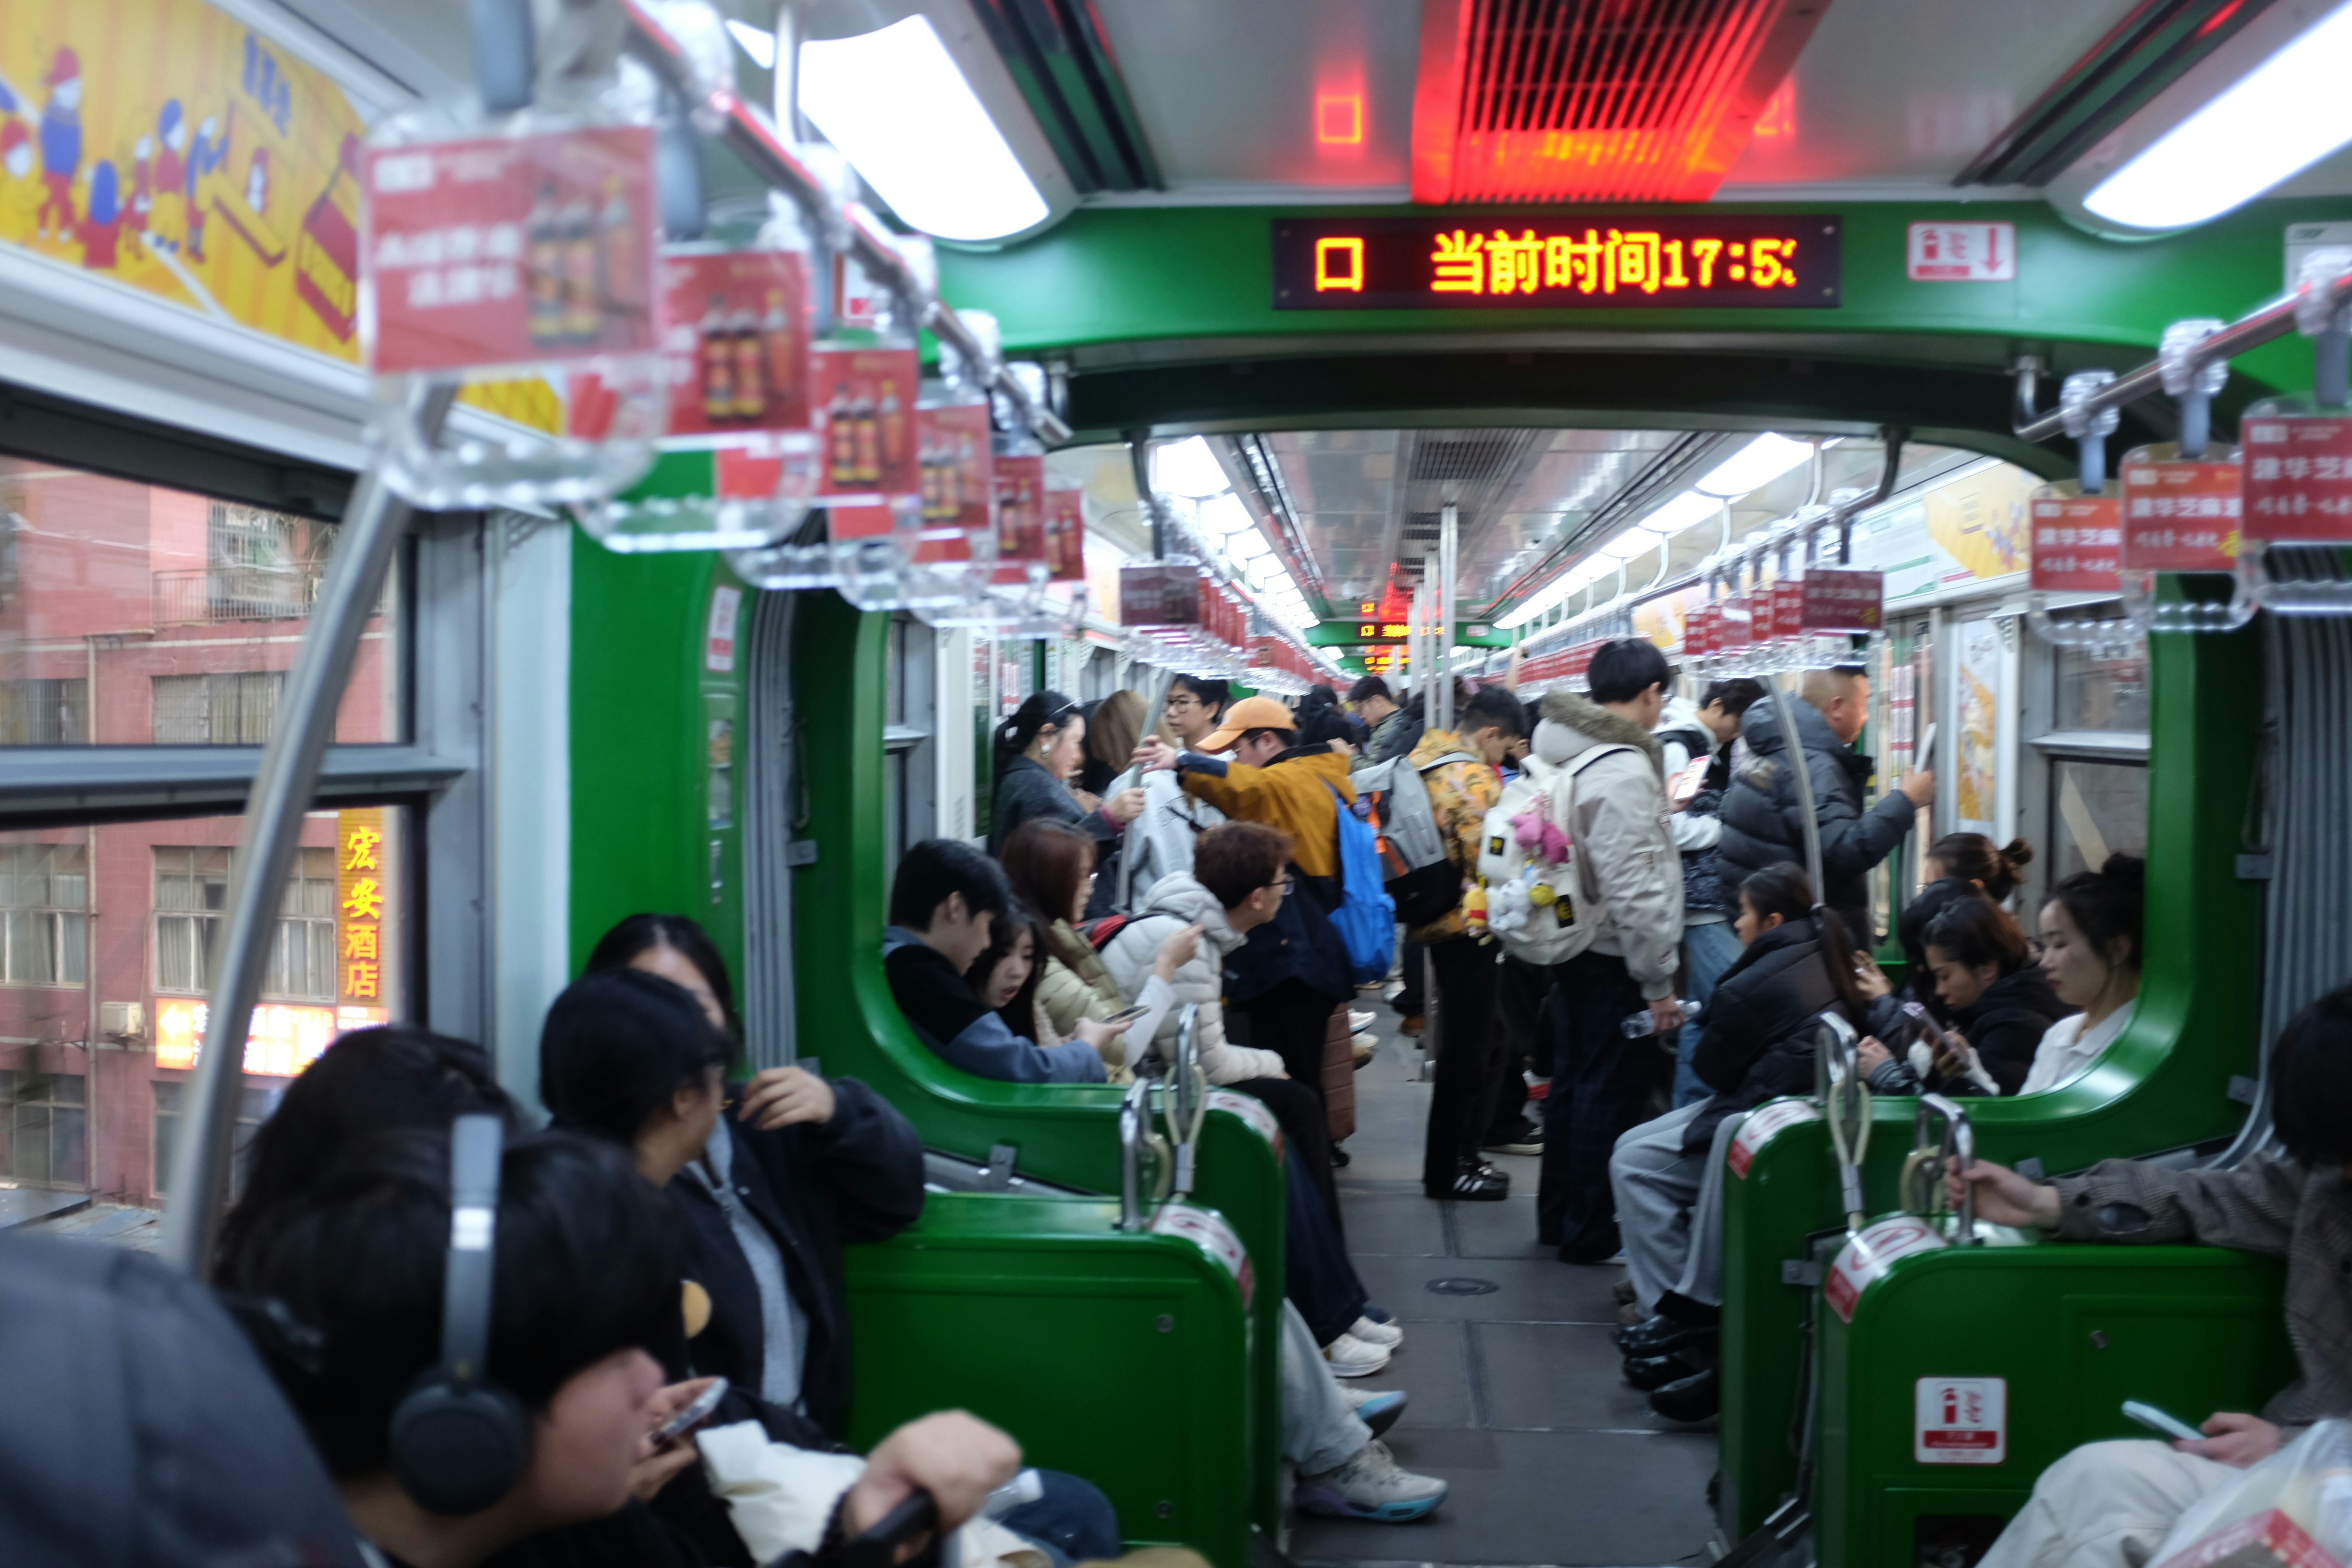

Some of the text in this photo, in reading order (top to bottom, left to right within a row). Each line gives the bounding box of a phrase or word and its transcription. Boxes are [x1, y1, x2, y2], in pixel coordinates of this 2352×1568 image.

[1316, 237, 1363, 291] 口
[343, 826, 382, 998] 宏安酒店
